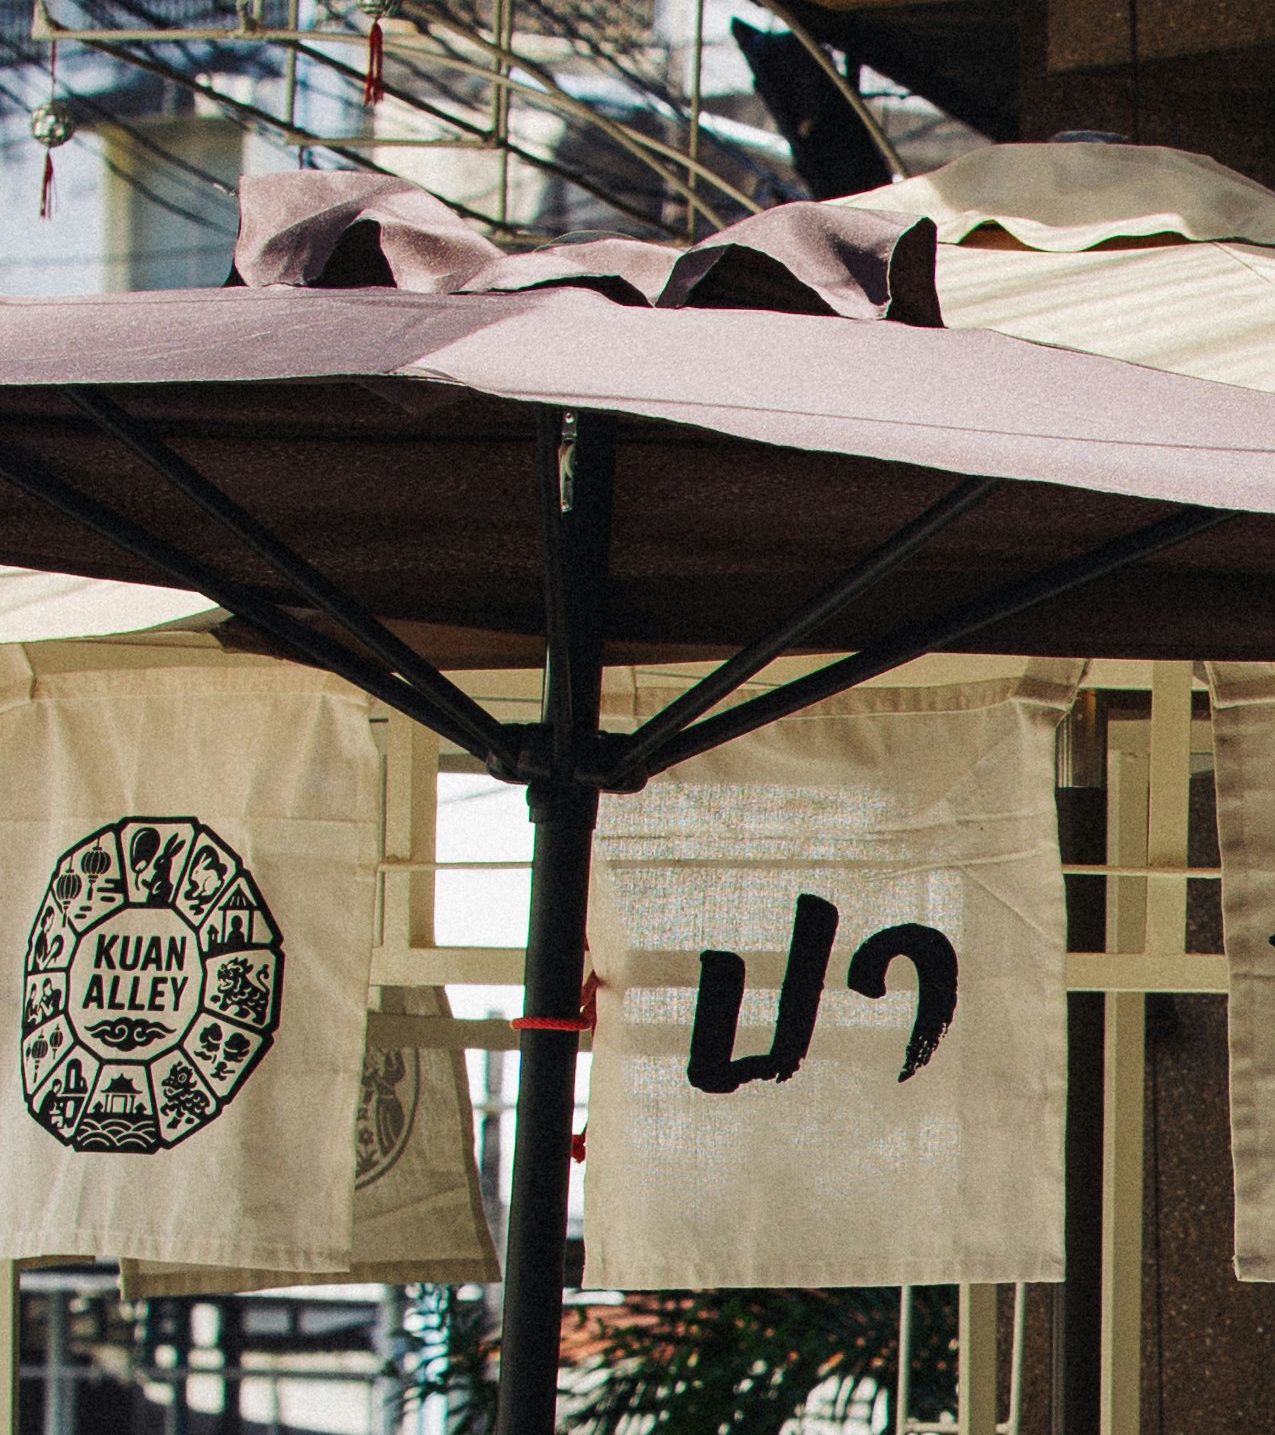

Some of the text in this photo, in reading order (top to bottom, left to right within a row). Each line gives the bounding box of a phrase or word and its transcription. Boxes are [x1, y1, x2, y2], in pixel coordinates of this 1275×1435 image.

[93, 934, 187, 972] KUAN
[82, 974, 189, 1012] ALLEY
[687, 893, 958, 1094] ปา
